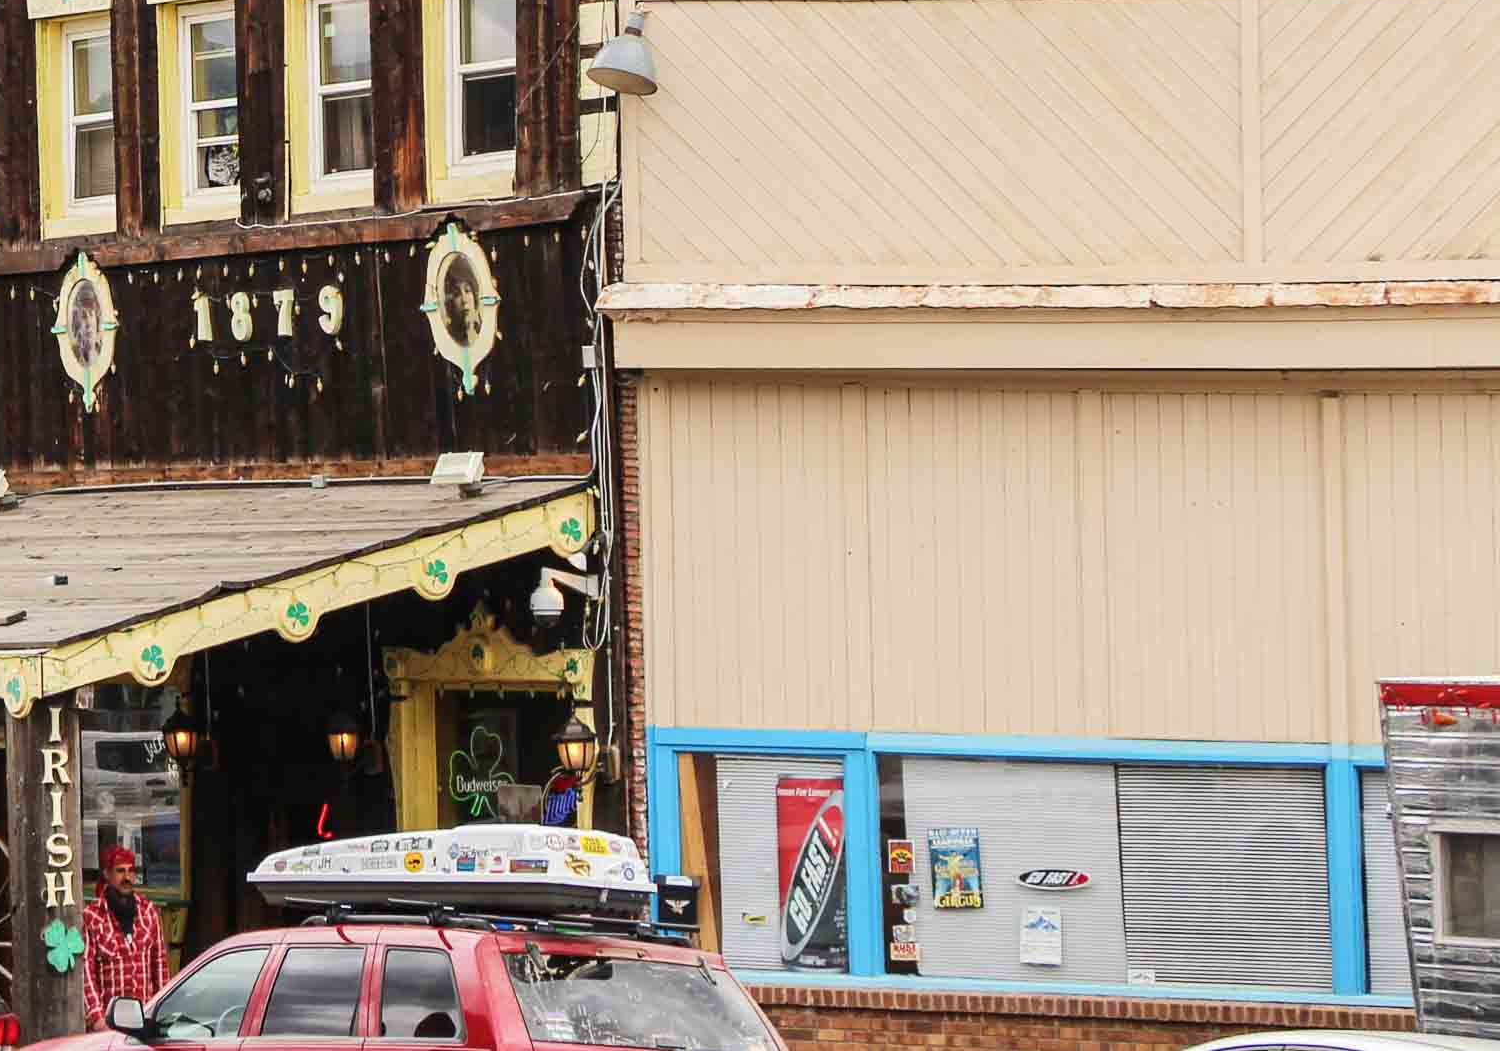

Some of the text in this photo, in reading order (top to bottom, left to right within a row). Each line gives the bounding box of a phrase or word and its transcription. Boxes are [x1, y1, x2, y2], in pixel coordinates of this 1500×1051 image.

[191, 284, 344, 342] 1879
[41, 707, 76, 908] IRISH
[788, 886, 813, 935] GO
